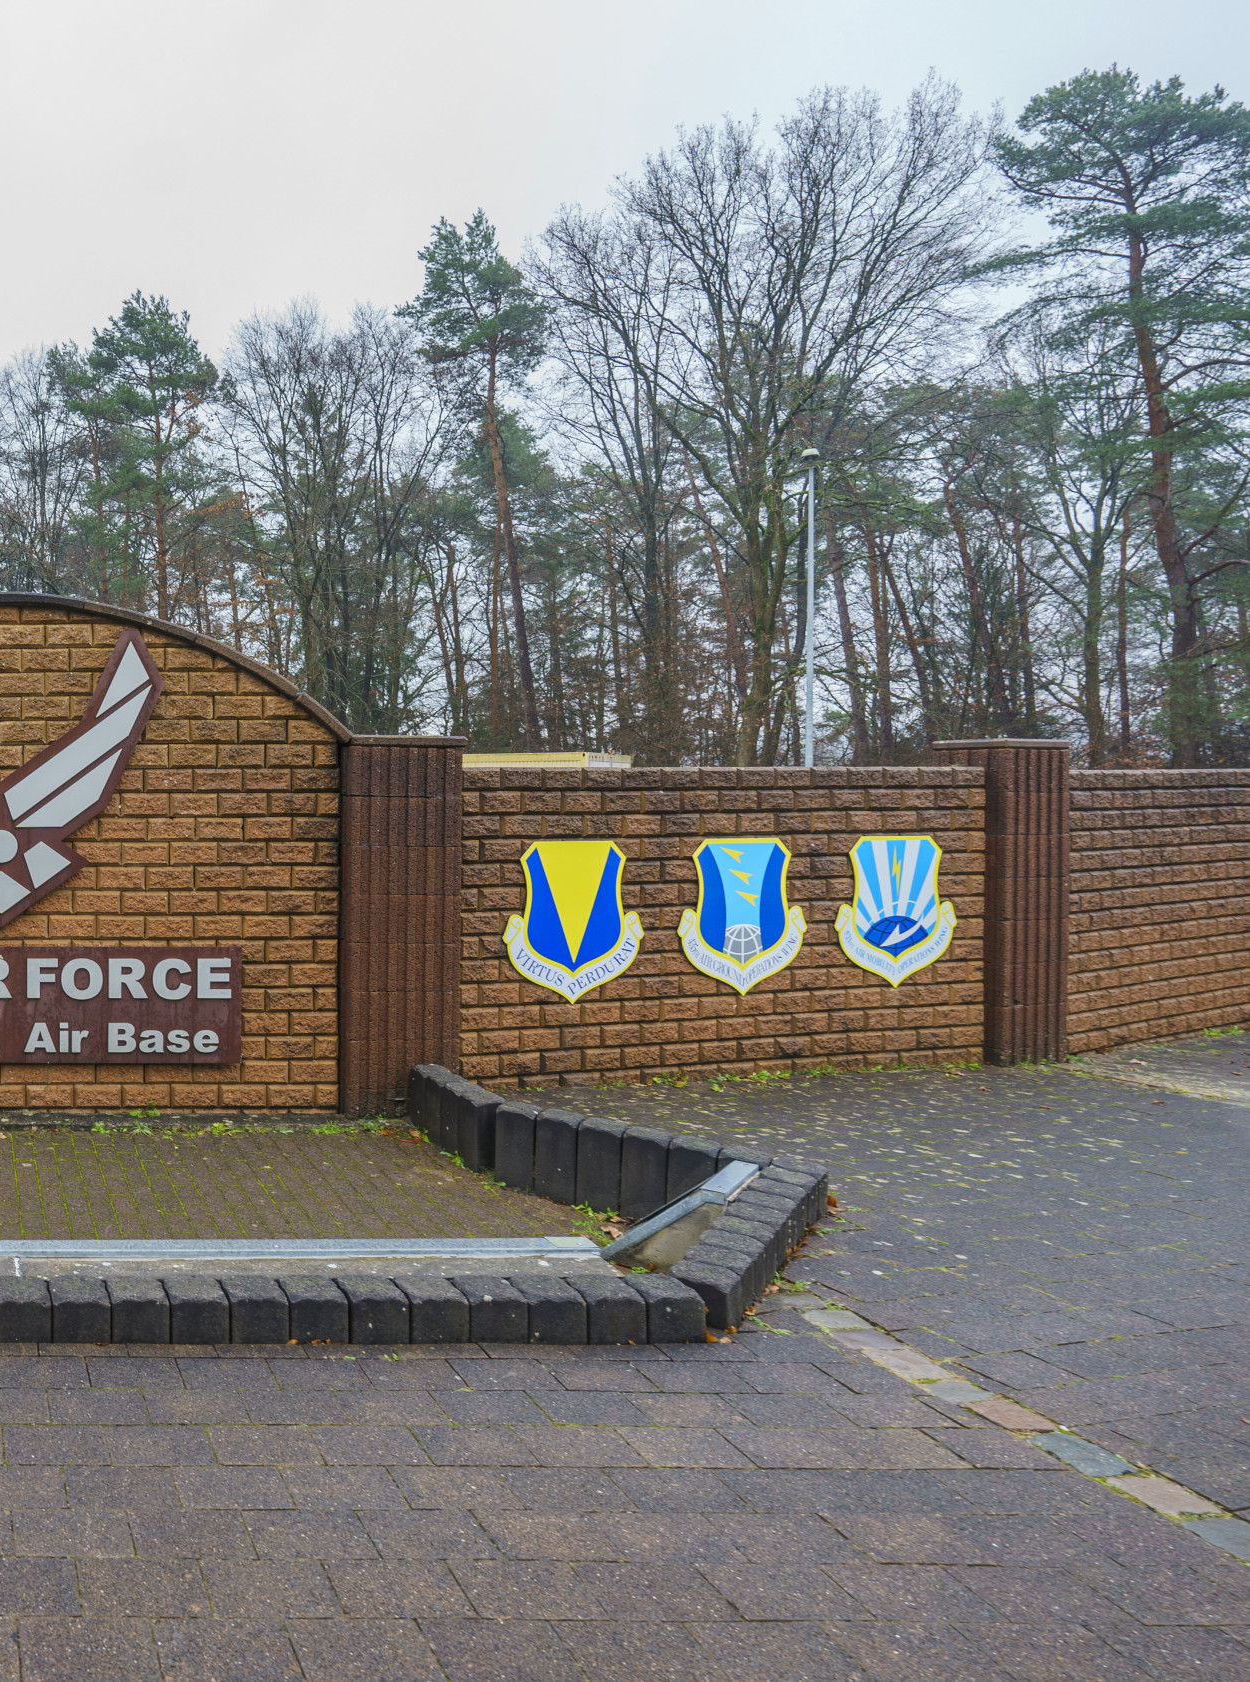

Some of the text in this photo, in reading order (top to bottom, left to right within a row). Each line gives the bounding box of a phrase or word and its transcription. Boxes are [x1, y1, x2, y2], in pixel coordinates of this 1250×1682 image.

[26, 957, 233, 1000] FORCE
[516, 937, 636, 995] VIRTUS PERDURAT
[24, 1022, 90, 1053] Air
[107, 1022, 220, 1054] Base
